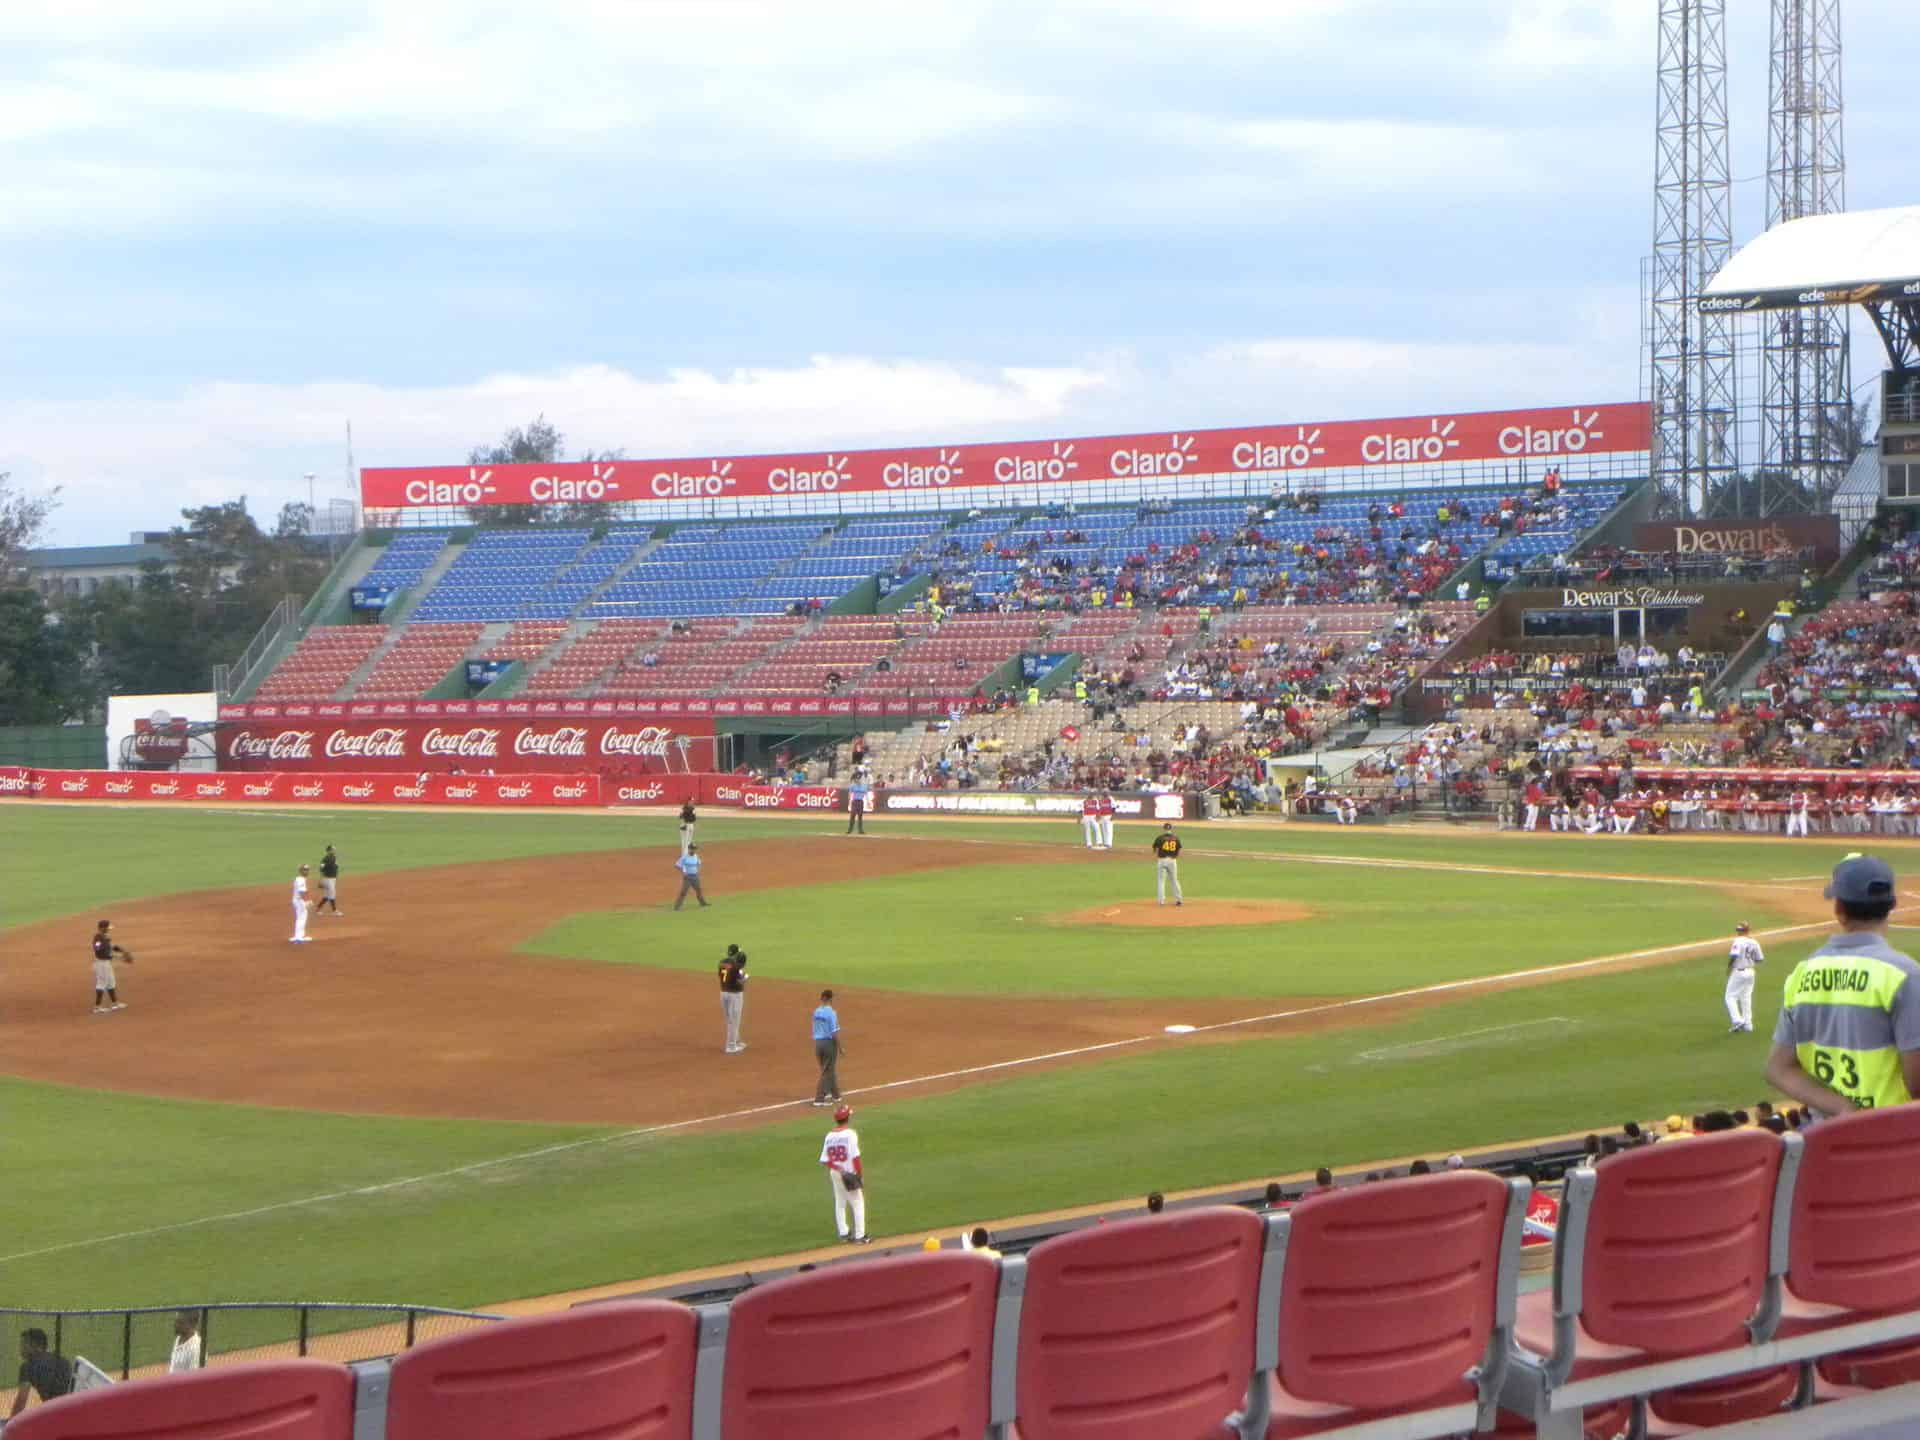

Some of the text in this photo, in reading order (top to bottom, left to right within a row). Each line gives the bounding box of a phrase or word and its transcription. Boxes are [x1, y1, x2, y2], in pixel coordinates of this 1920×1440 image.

[1361, 432, 1446, 462] Claro
[1498, 423, 1588, 454] Claro
[994, 453, 1067, 482] Claro
[1110, 447, 1186, 476] Claro
[1232, 439, 1312, 469] Claro
[530, 474, 607, 501] Claro
[651, 470, 725, 497] Claro
[768, 465, 841, 492] Claro
[883, 460, 953, 488] Claro
[405, 477, 485, 504] Claro
[326, 728, 407, 757] Coca-Cola
[422, 728, 499, 757] Coca-Cola
[514, 728, 588, 757] Coca-Cola
[552, 784, 583, 799] Claro
[618, 786, 657, 800] Claro
[716, 786, 741, 800] Clar
[745, 792, 780, 807] Claro
[797, 792, 833, 807] Claro
[1814, 1050, 1859, 1089] 63
